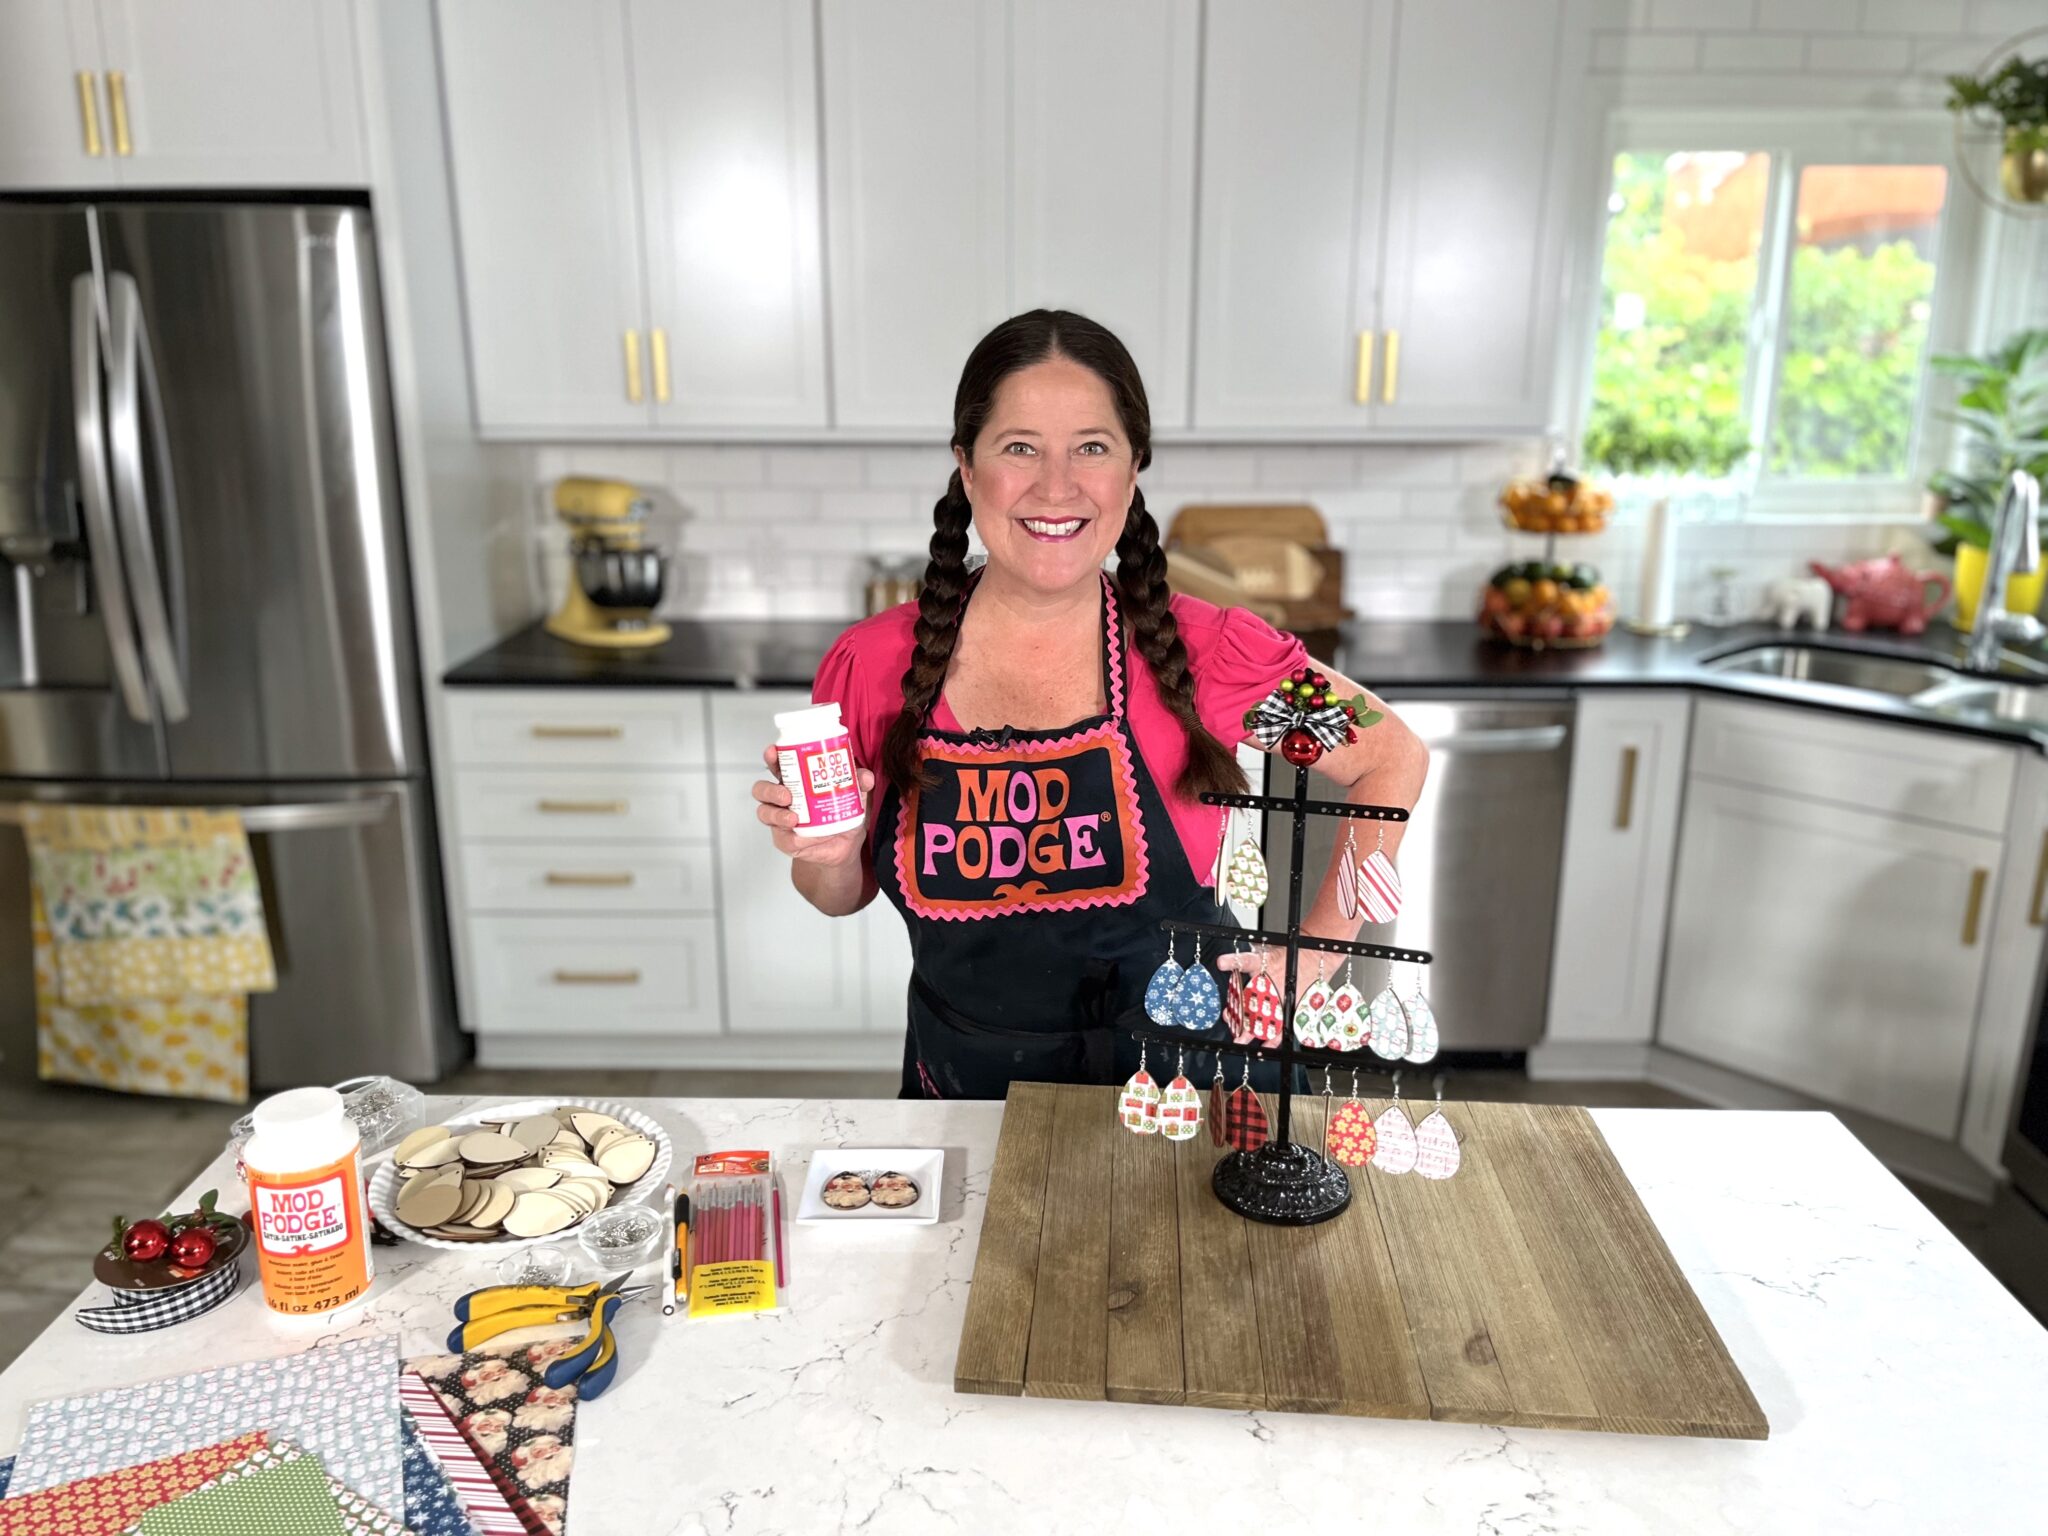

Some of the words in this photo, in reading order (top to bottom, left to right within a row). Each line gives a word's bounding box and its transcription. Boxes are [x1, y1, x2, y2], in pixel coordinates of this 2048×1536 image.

[817, 752, 843, 769] MOD
[955, 768, 1070, 823] MOD
[922, 813, 1107, 880] PODGE
[270, 1189, 324, 1213] MOD
[261, 1205, 338, 1234] PODGE
[279, 1301, 289, 1311] fl
[292, 1304, 309, 1313] oz
[313, 1295, 340, 1311] 473
[344, 1284, 360, 1301] ml
